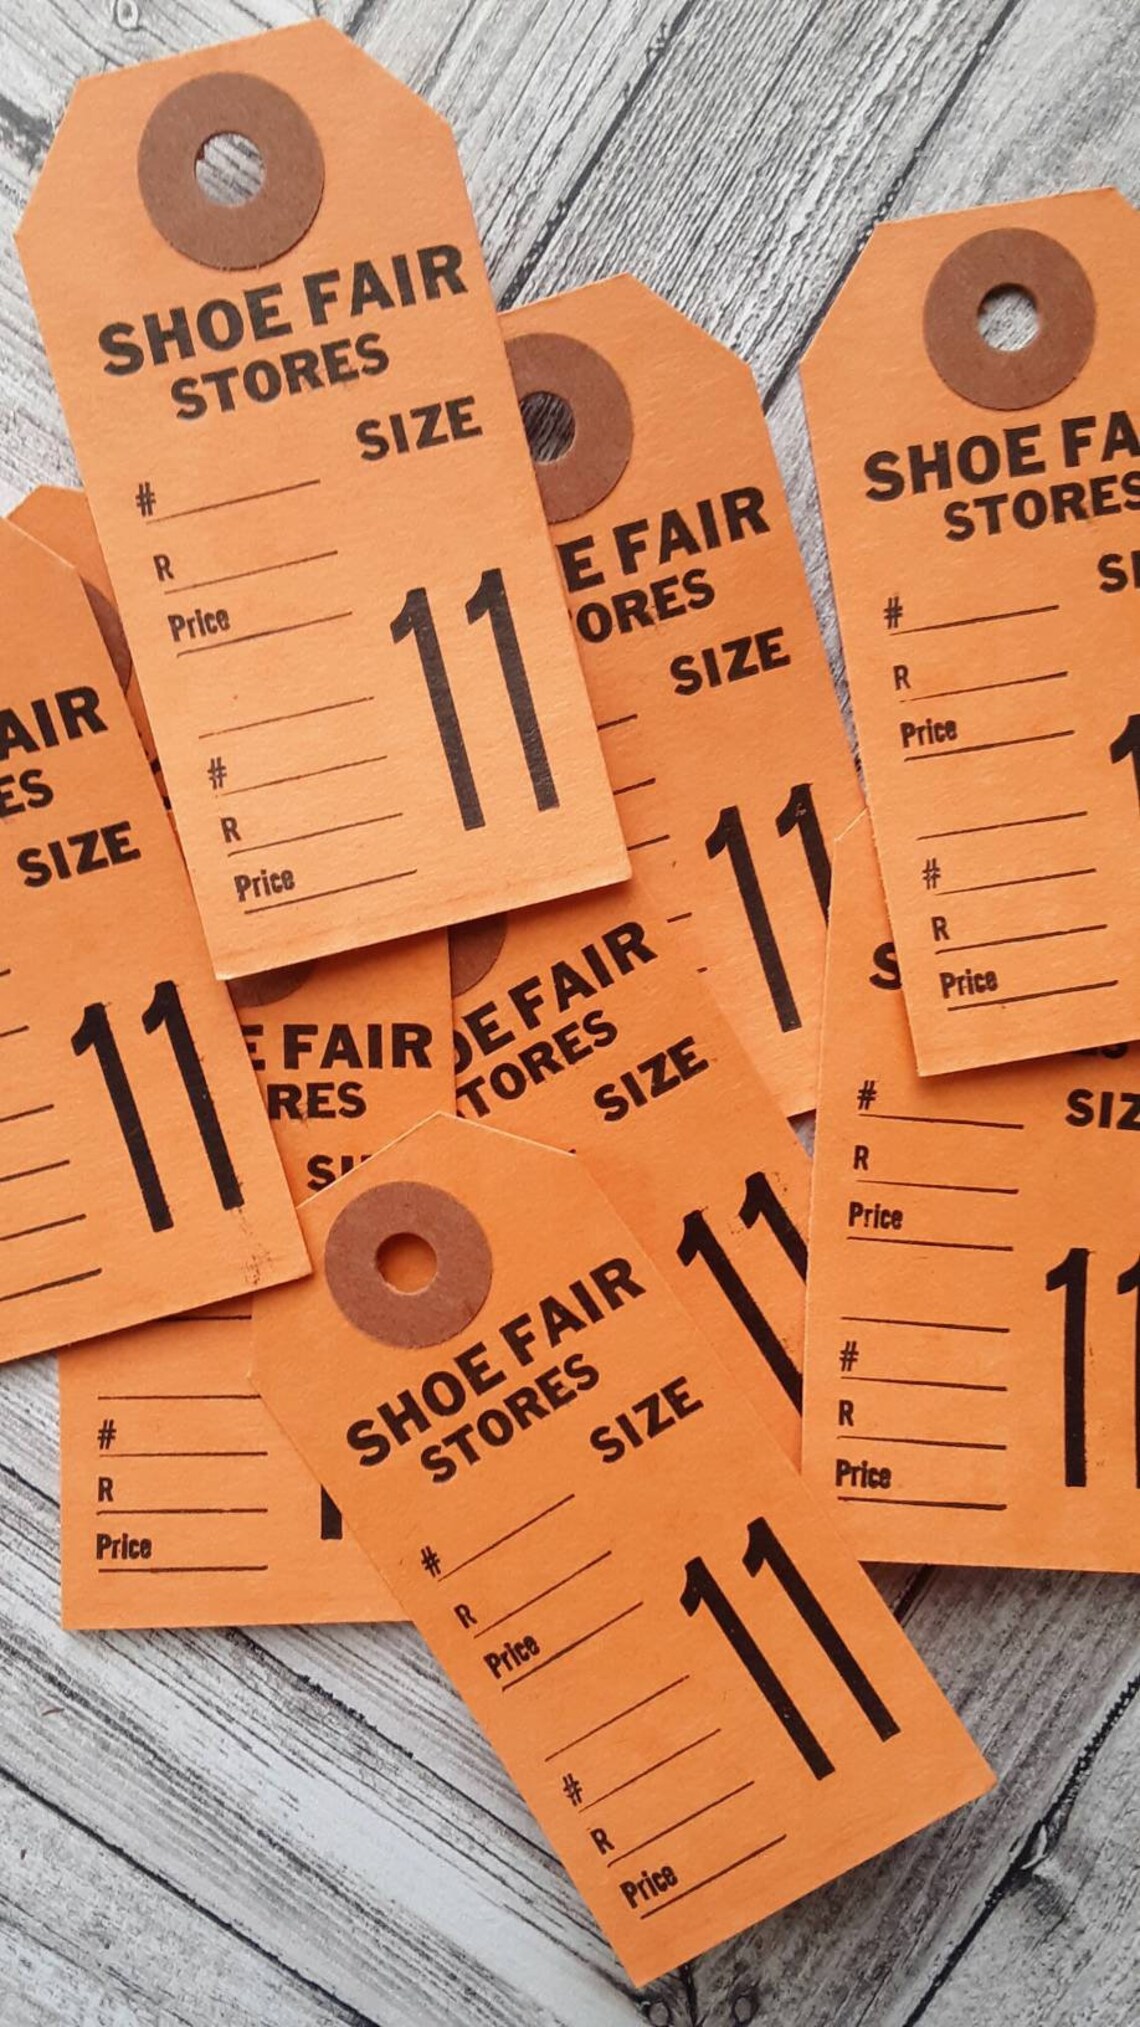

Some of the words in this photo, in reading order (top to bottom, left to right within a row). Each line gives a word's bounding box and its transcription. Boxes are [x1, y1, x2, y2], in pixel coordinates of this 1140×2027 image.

[99, 284, 292, 375] SHOE
[303, 245, 467, 325] FAIR
[172, 334, 388, 419] STORES
[357, 396, 482, 460] SIZE
[865, 425, 1045, 501] SHOE
[1062, 411, 1140, 467] FA
[136, 482, 155, 516] #
[945, 471, 1140, 541] STORES
[613, 487, 769, 575] FAIR
[153, 555, 174, 581] R
[1098, 551, 1140, 592] SI
[577, 569, 714, 643] ORES
[883, 597, 904, 629] #
[168, 609, 230, 641] Price
[671, 627, 790, 695] SIZE
[893, 664, 911, 690] R
[391, 569, 558, 830] 11
[0, 687, 107, 761] AIR
[901, 720, 957, 748] Price
[206, 757, 227, 790] #
[221, 817, 241, 842] R
[18, 821, 140, 887] SIZE
[235, 870, 295, 900] Price
[922, 856, 941, 890] #
[931, 916, 950, 941] R
[508, 922, 657, 1029] FAIR
[940, 971, 998, 999] Price
[284, 1024, 432, 1069] FAIR
[456, 1011, 617, 1119] TORES
[594, 1037, 708, 1121] SIZE
[71, 981, 244, 1232] 11
[267, 1082, 366, 1120] RES
[857, 1080, 878, 1110] #
[1066, 1089, 1140, 1131] SIZ
[853, 1145, 870, 1170] R
[849, 1201, 903, 1230] Price
[347, 1342, 506, 1466] SHOE
[500, 1259, 645, 1366] FAIR
[839, 1341, 859, 1372] #
[421, 1354, 598, 1482] STORES
[591, 1377, 703, 1462] SIZE
[838, 1399, 855, 1427] R
[97, 1419, 118, 1450] #
[98, 1477, 114, 1502] R
[835, 1458, 892, 1489] Price
[96, 1533, 152, 1560] Price
[420, 1546, 442, 1577] #
[454, 1604, 477, 1629] R
[484, 1634, 541, 1679] Price
[680, 1517, 900, 1780] 11
[562, 1773, 583, 1807] #
[590, 1828, 615, 1855] R
[620, 1866, 678, 1909] Price
